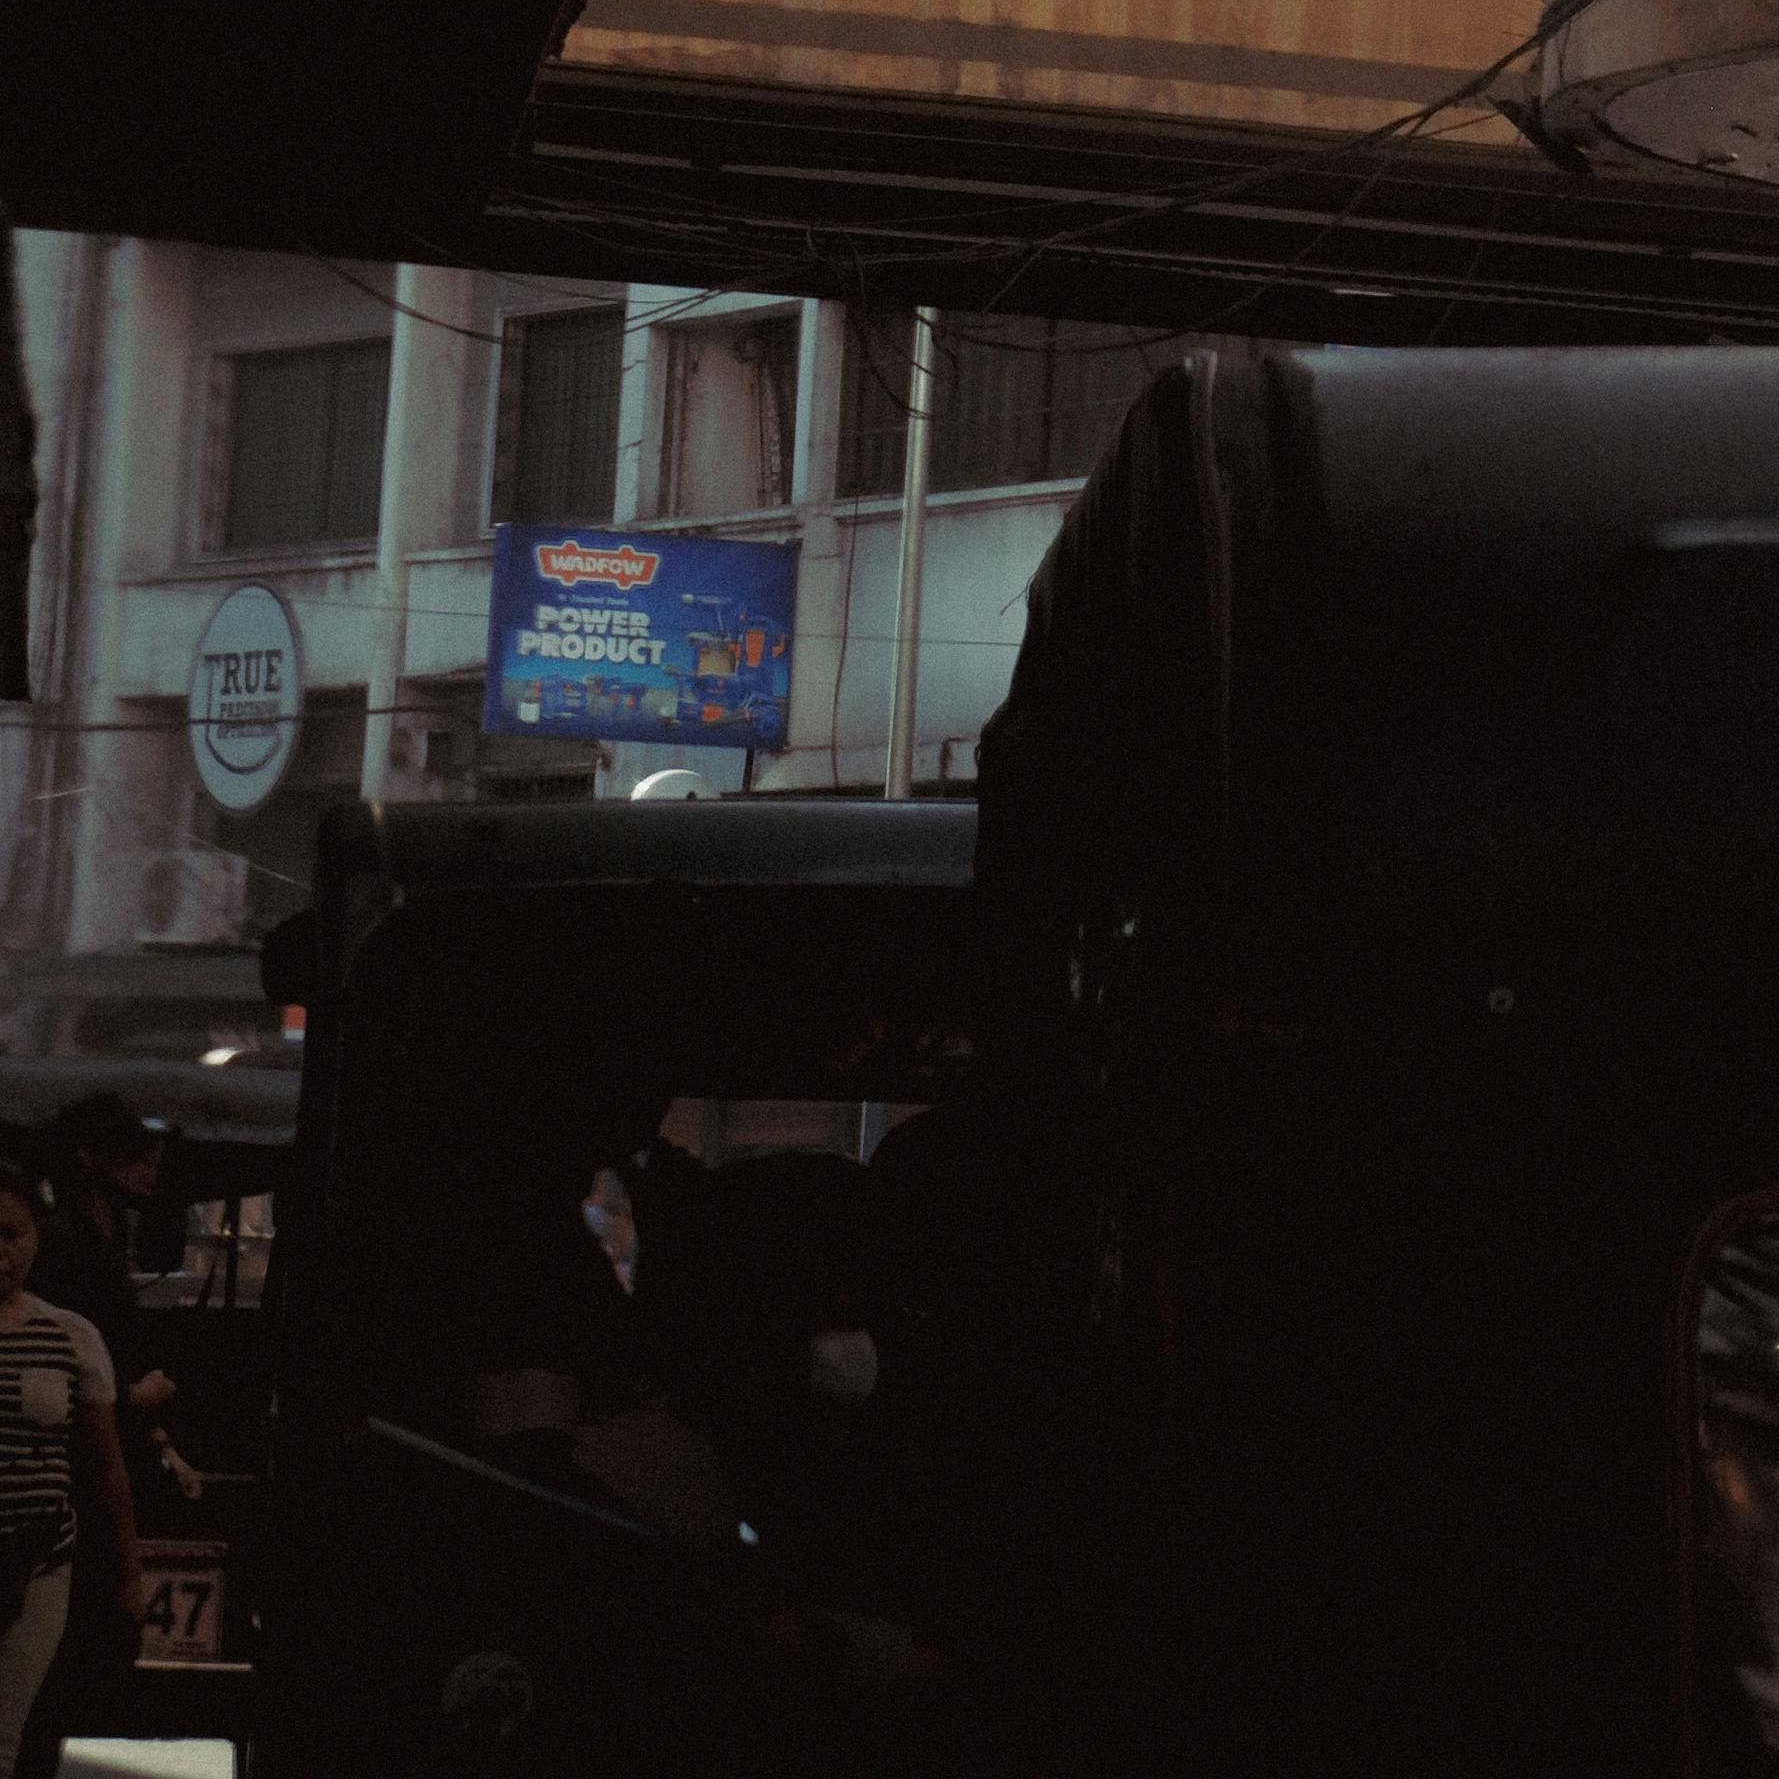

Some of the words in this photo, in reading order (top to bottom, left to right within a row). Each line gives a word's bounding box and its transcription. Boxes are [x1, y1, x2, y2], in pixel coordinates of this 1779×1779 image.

[549, 553, 645, 577] WADFOW
[535, 604, 651, 639] POWER
[516, 629, 667, 666] PRODUCT
[204, 649, 283, 696] TRUE
[144, 1579, 211, 1637] 47
